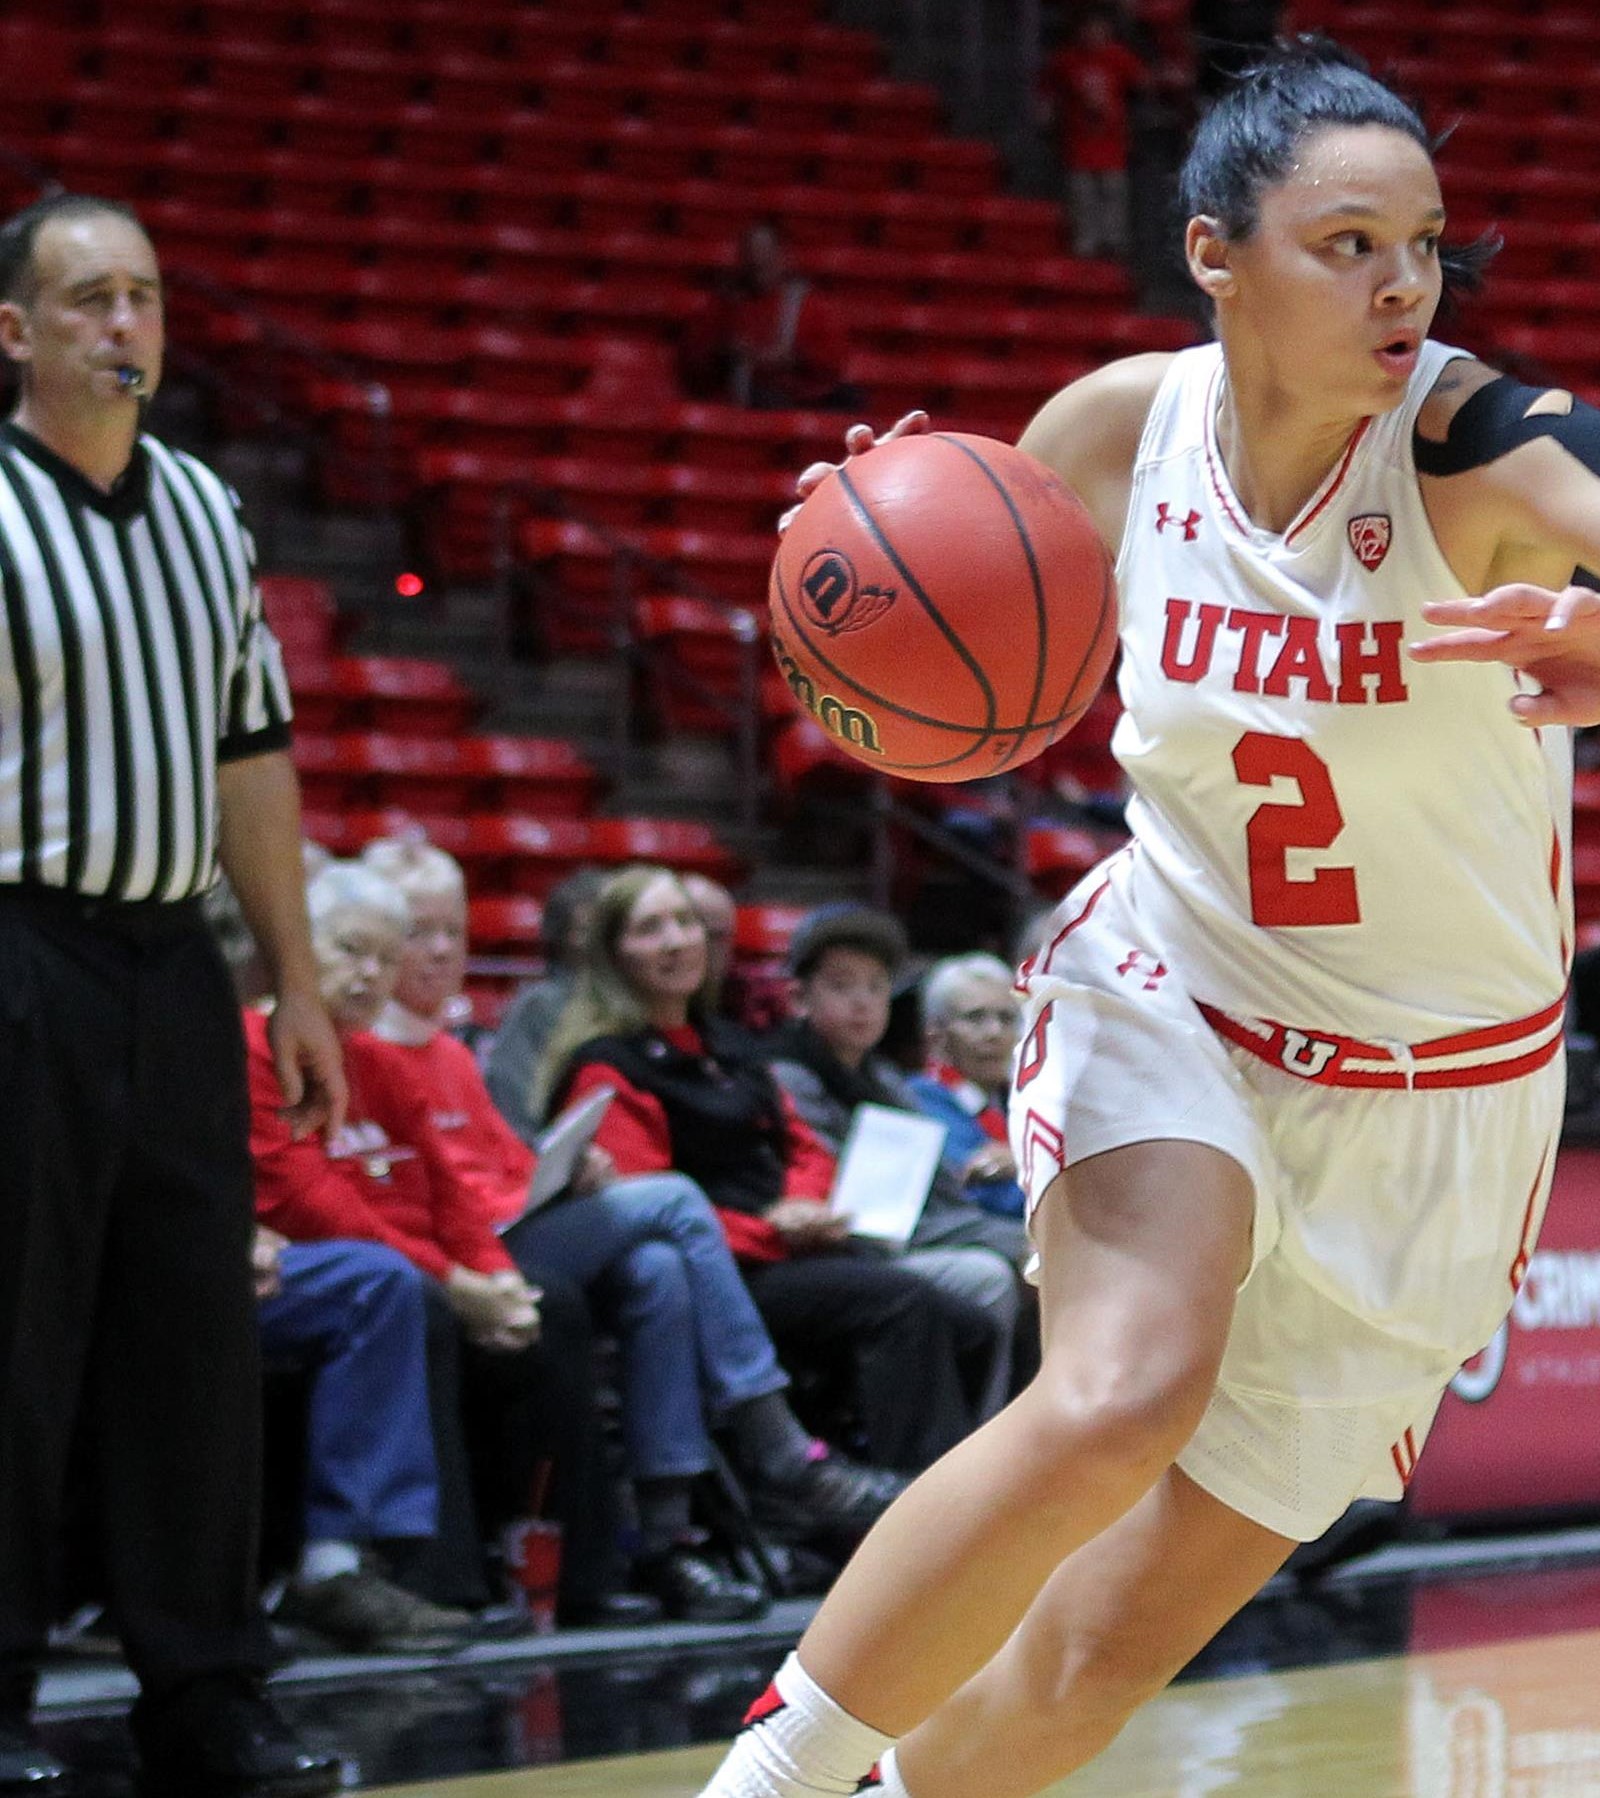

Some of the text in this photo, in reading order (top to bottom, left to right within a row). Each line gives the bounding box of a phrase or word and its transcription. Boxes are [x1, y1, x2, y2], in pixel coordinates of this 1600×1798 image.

[1163, 598, 1408, 704] UTAH
[1232, 731, 1362, 928] 2
[1281, 1029, 1338, 1077] U
